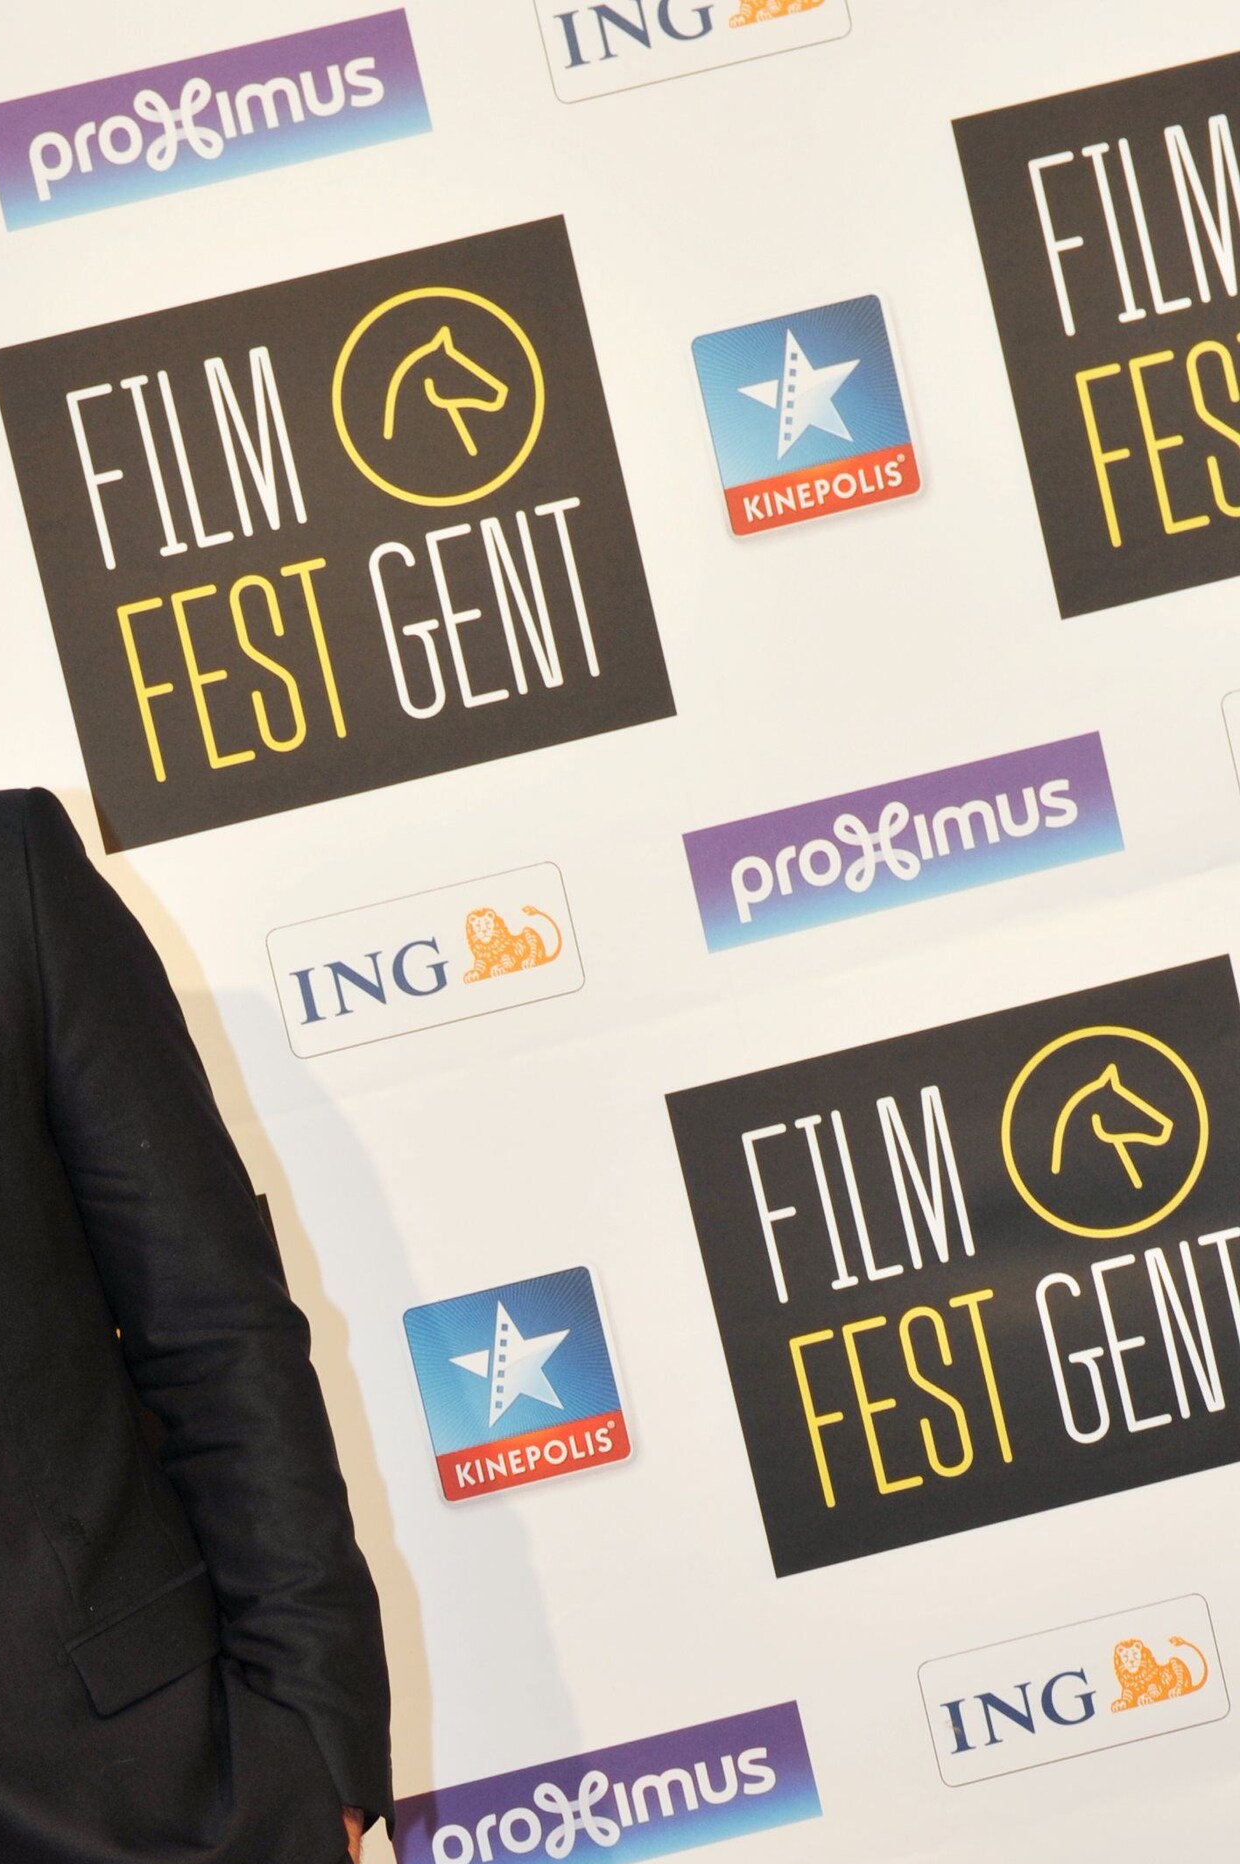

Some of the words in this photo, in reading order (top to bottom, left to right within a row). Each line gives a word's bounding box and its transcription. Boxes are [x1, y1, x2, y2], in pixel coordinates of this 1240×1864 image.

[28, 57, 386, 201] proximus
[553, 0, 715, 69] ING
[1028, 114, 1240, 336] FILM
[66, 347, 307, 570] FILM
[1075, 333, 1240, 547] FES
[117, 558, 346, 782] FEST
[369, 497, 599, 719] GENT
[730, 778, 1078, 922] proximus
[290, 936, 449, 1025] ING
[742, 1086, 975, 1303] FILM
[789, 1289, 1012, 1507] FEST
[1036, 1227, 1240, 1443] GENT
[939, 1668, 1096, 1755] ING
